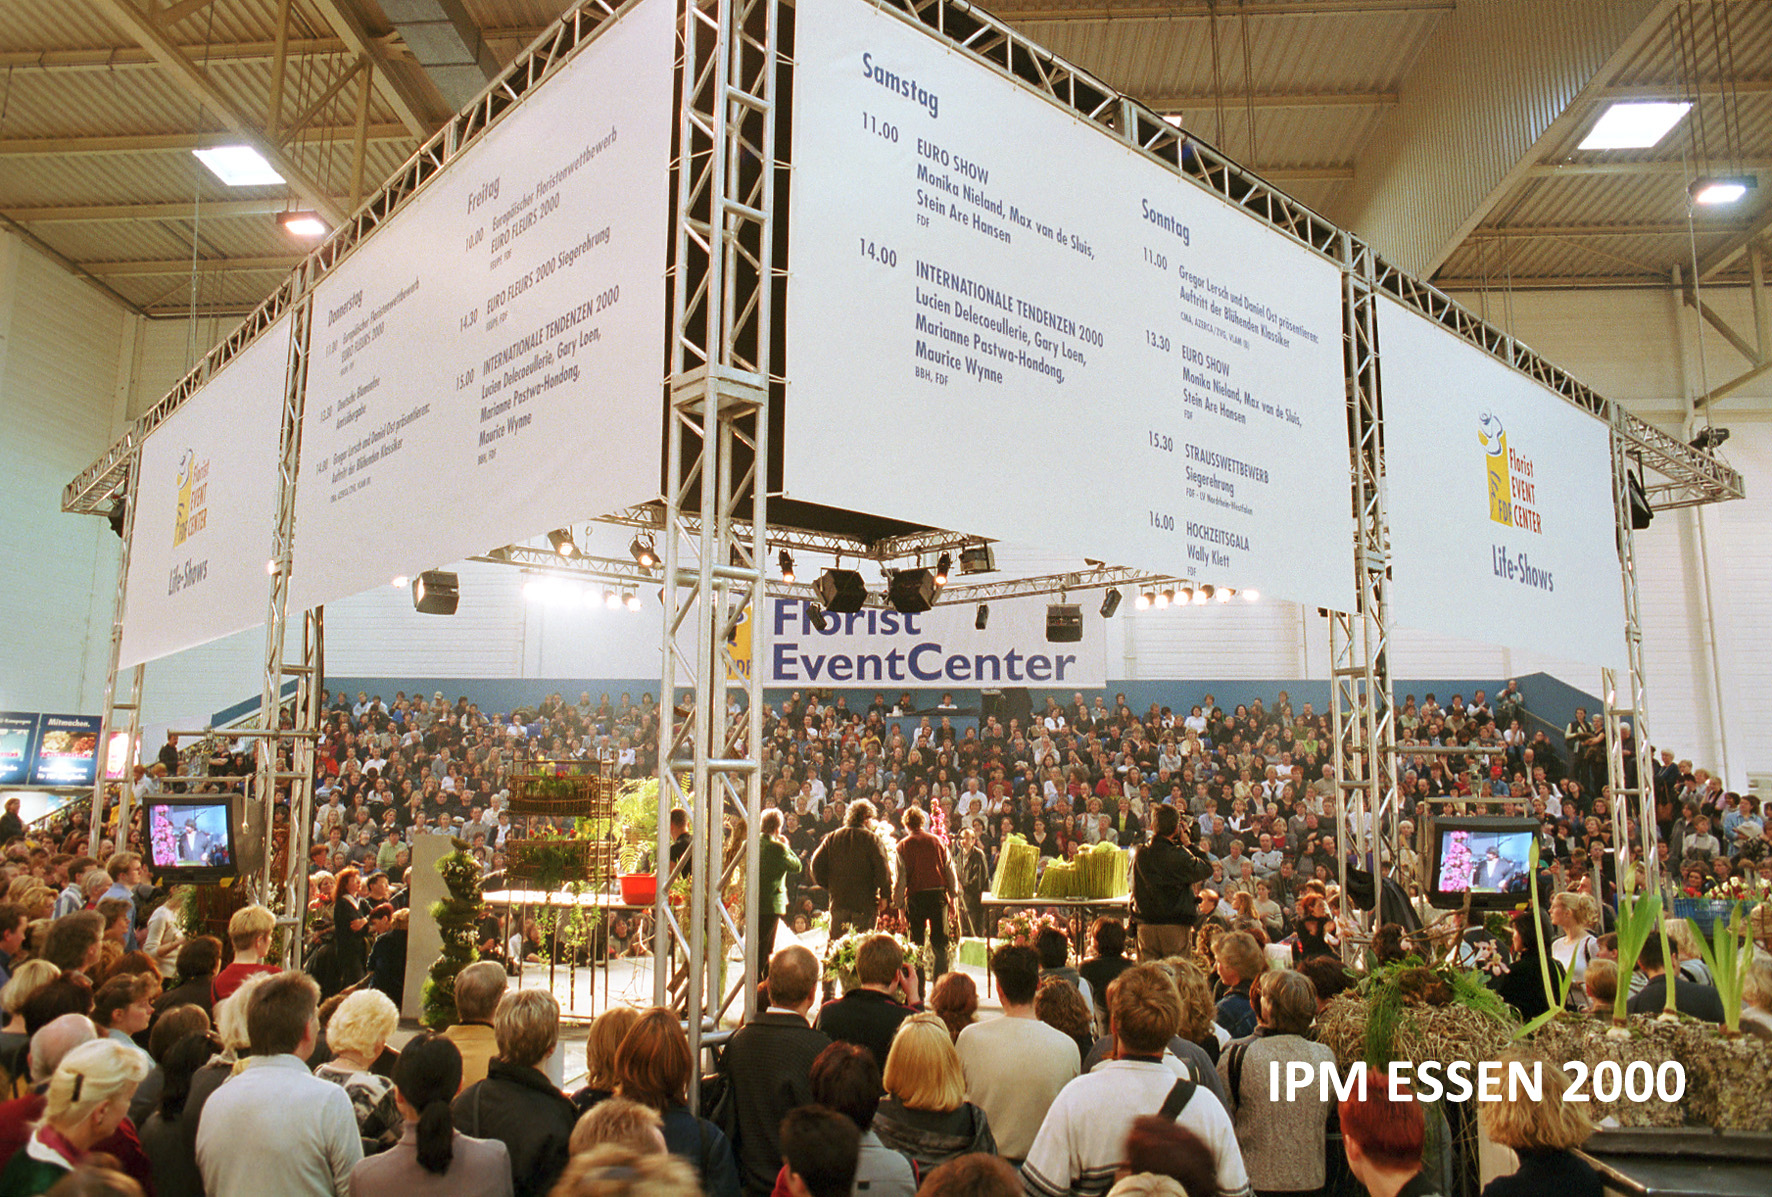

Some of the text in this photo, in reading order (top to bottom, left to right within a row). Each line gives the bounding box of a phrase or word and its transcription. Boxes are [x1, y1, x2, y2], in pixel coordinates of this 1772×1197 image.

[863, 52, 938, 118] Samstag
[862, 112, 898, 143] 11.00
[492, 125, 617, 232] Europäischer Floristenwettbewerb
[917, 138, 989, 185] EURO SHOW
[467, 176, 501, 215] Freitag
[917, 163, 1095, 260] Monika Nieland, Max van de Sluis,
[491, 192, 560, 254] EURO FLEURS 2000
[916, 214, 930, 228] FDF
[917, 189, 1011, 244] Stein Are Hansen
[1142, 198, 1190, 247] Sonntag
[465, 226, 484, 252] 10.00
[860, 238, 896, 267] 14.00
[486, 226, 611, 315] EURO FLEURS 2000 Siegerehrung
[1143, 247, 1168, 270] 11.00
[328, 289, 363, 327] Donnerstag
[916, 260, 1104, 348] INTERNATIONALE TENDENZEN 2000
[1179, 265, 1205, 289] Gregor
[1206, 278, 1229, 300] Lersch
[1230, 293, 1243, 307] und
[1244, 296, 1265, 318] Daniel
[1266, 307, 1278, 324] Ost
[460, 308, 478, 332] 14.30
[483, 284, 620, 377] INTERNATIONALE TENDENZEN 2000
[916, 286, 1086, 366] Lucien Delecoeullerie, Gary Loen,
[1180, 286, 1290, 348] Auftritt der Blühenden Klassiker
[915, 313, 1065, 384] Marianne Pastwa-Hondong,
[1146, 329, 1171, 352] 13.30
[482, 327, 602, 400] Lucien Delecoeullerie, Gary Loen,
[915, 340, 1003, 384] Maurice Wynne
[915, 366, 949, 386] BBH, FDF
[1182, 345, 1230, 377] EURO SHOW
[456, 368, 475, 392] 15.00
[480, 364, 580, 424] Marianne Pastwa-Hondong,
[1183, 367, 1302, 428] Monika Nieland, Max van de Sluis,
[1183, 388, 1246, 424] Stein Are Hansen
[1184, 409, 1193, 420] FDF
[478, 412, 532, 448] Maurice Wynne
[1149, 430, 1174, 452] 15.30
[1185, 443, 1269, 484] STRAUSSWETTBEWERB
[1508, 447, 1534, 478] Florist
[190, 482, 208, 513] EVENT
[1186, 466, 1234, 498] Siegerehrung
[1186, 488, 1195, 499] FDF
[1200, 491, 1206, 501] LV
[1511, 476, 1536, 505] EVENT
[188, 507, 208, 538] CENTER
[1150, 511, 1174, 532] 16.00
[1498, 499, 1542, 535] FDF CENTER
[1186, 521, 1250, 551] HOCHZEITSGALA
[1187, 543, 1230, 568] Wally Klett
[1187, 566, 1196, 576] FDF
[1492, 543, 1554, 593] Life-Shows
[168, 558, 208, 597] Life-Shows
[774, 598, 922, 636] Florist
[772, 642, 1076, 682] EventCenter
